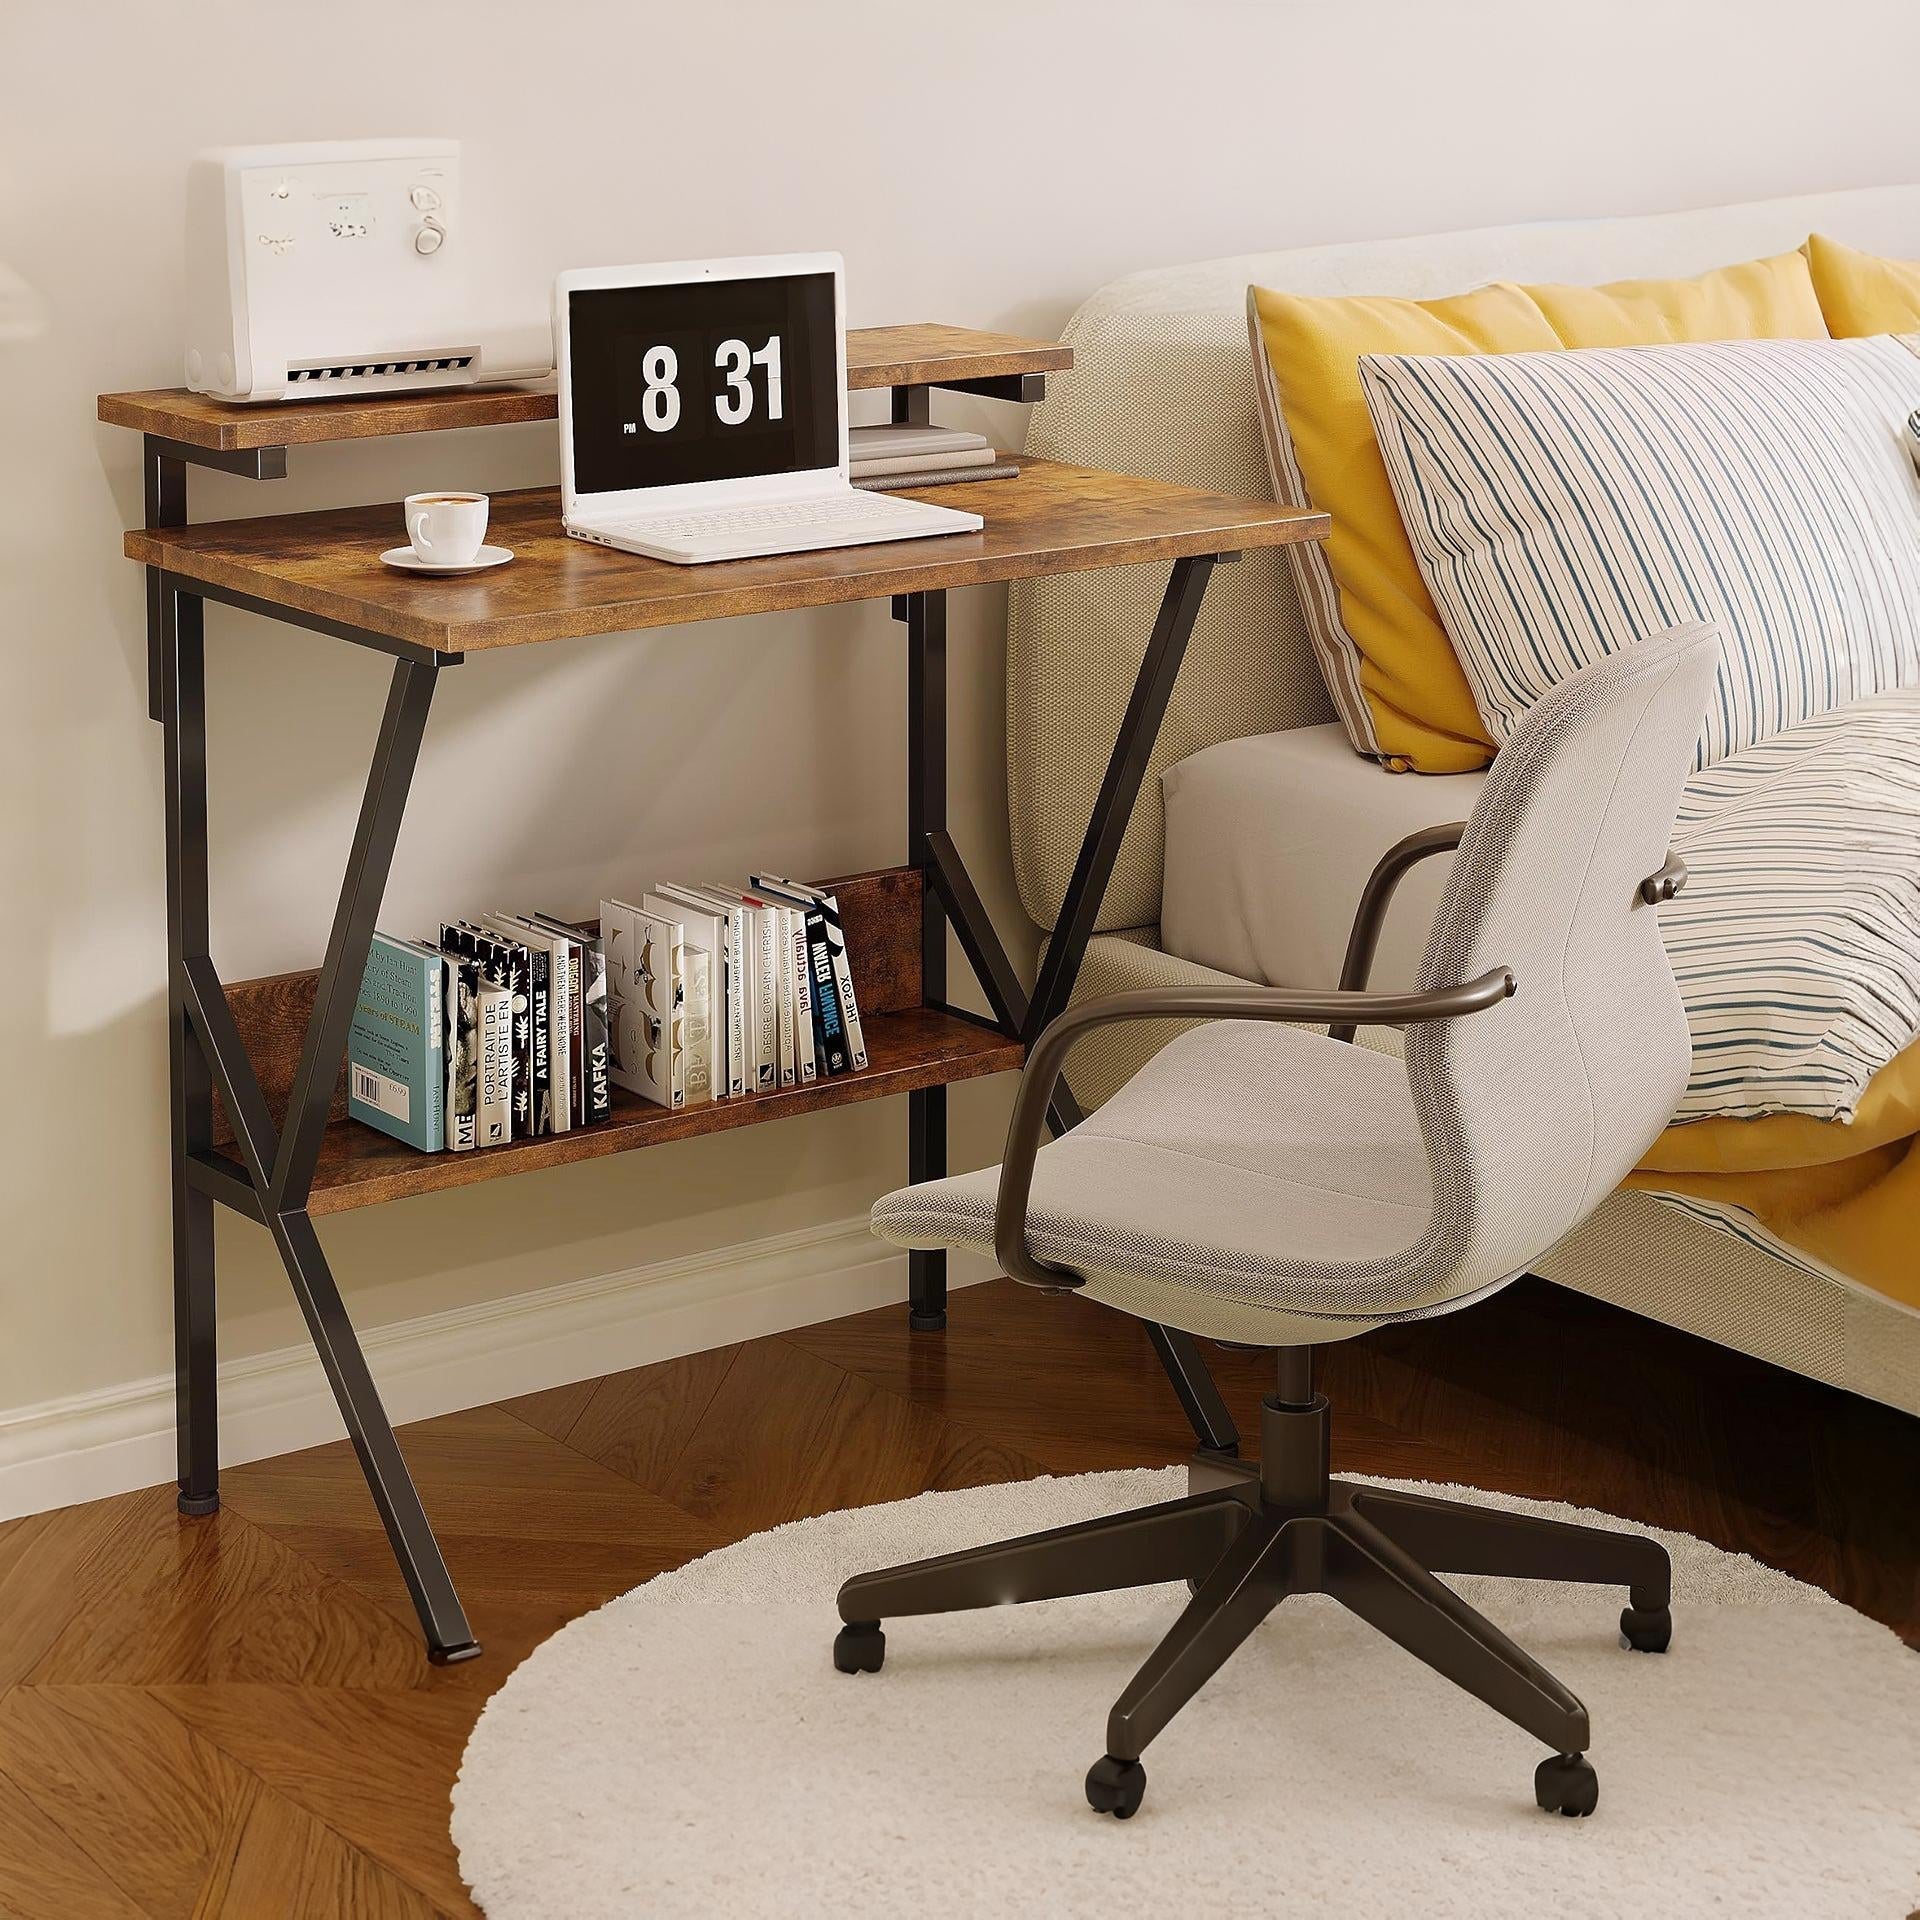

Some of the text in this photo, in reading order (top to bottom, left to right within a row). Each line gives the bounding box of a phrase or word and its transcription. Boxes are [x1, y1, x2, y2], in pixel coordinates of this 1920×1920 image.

[623, 335, 783, 434] PM 8 31
[733, 915, 741, 956] BUILDING
[535, 989, 547, 1025] TALE
[557, 954, 566, 1056] AND THEN THERE WERE NONE
[762, 920, 772, 1054] DESIRE OBTAIN CHERISH
[388, 1014, 420, 1036] STEAM
[498, 1000, 509, 1101] L'ARTISTE EN
[536, 1028, 547, 1067] FAIRY
[484, 1003, 496, 1105] PORTRAIT DE
[536, 1068, 548, 1079] A
[592, 1042, 608, 1110] KAFKA
[458, 1115, 473, 1144] ME
